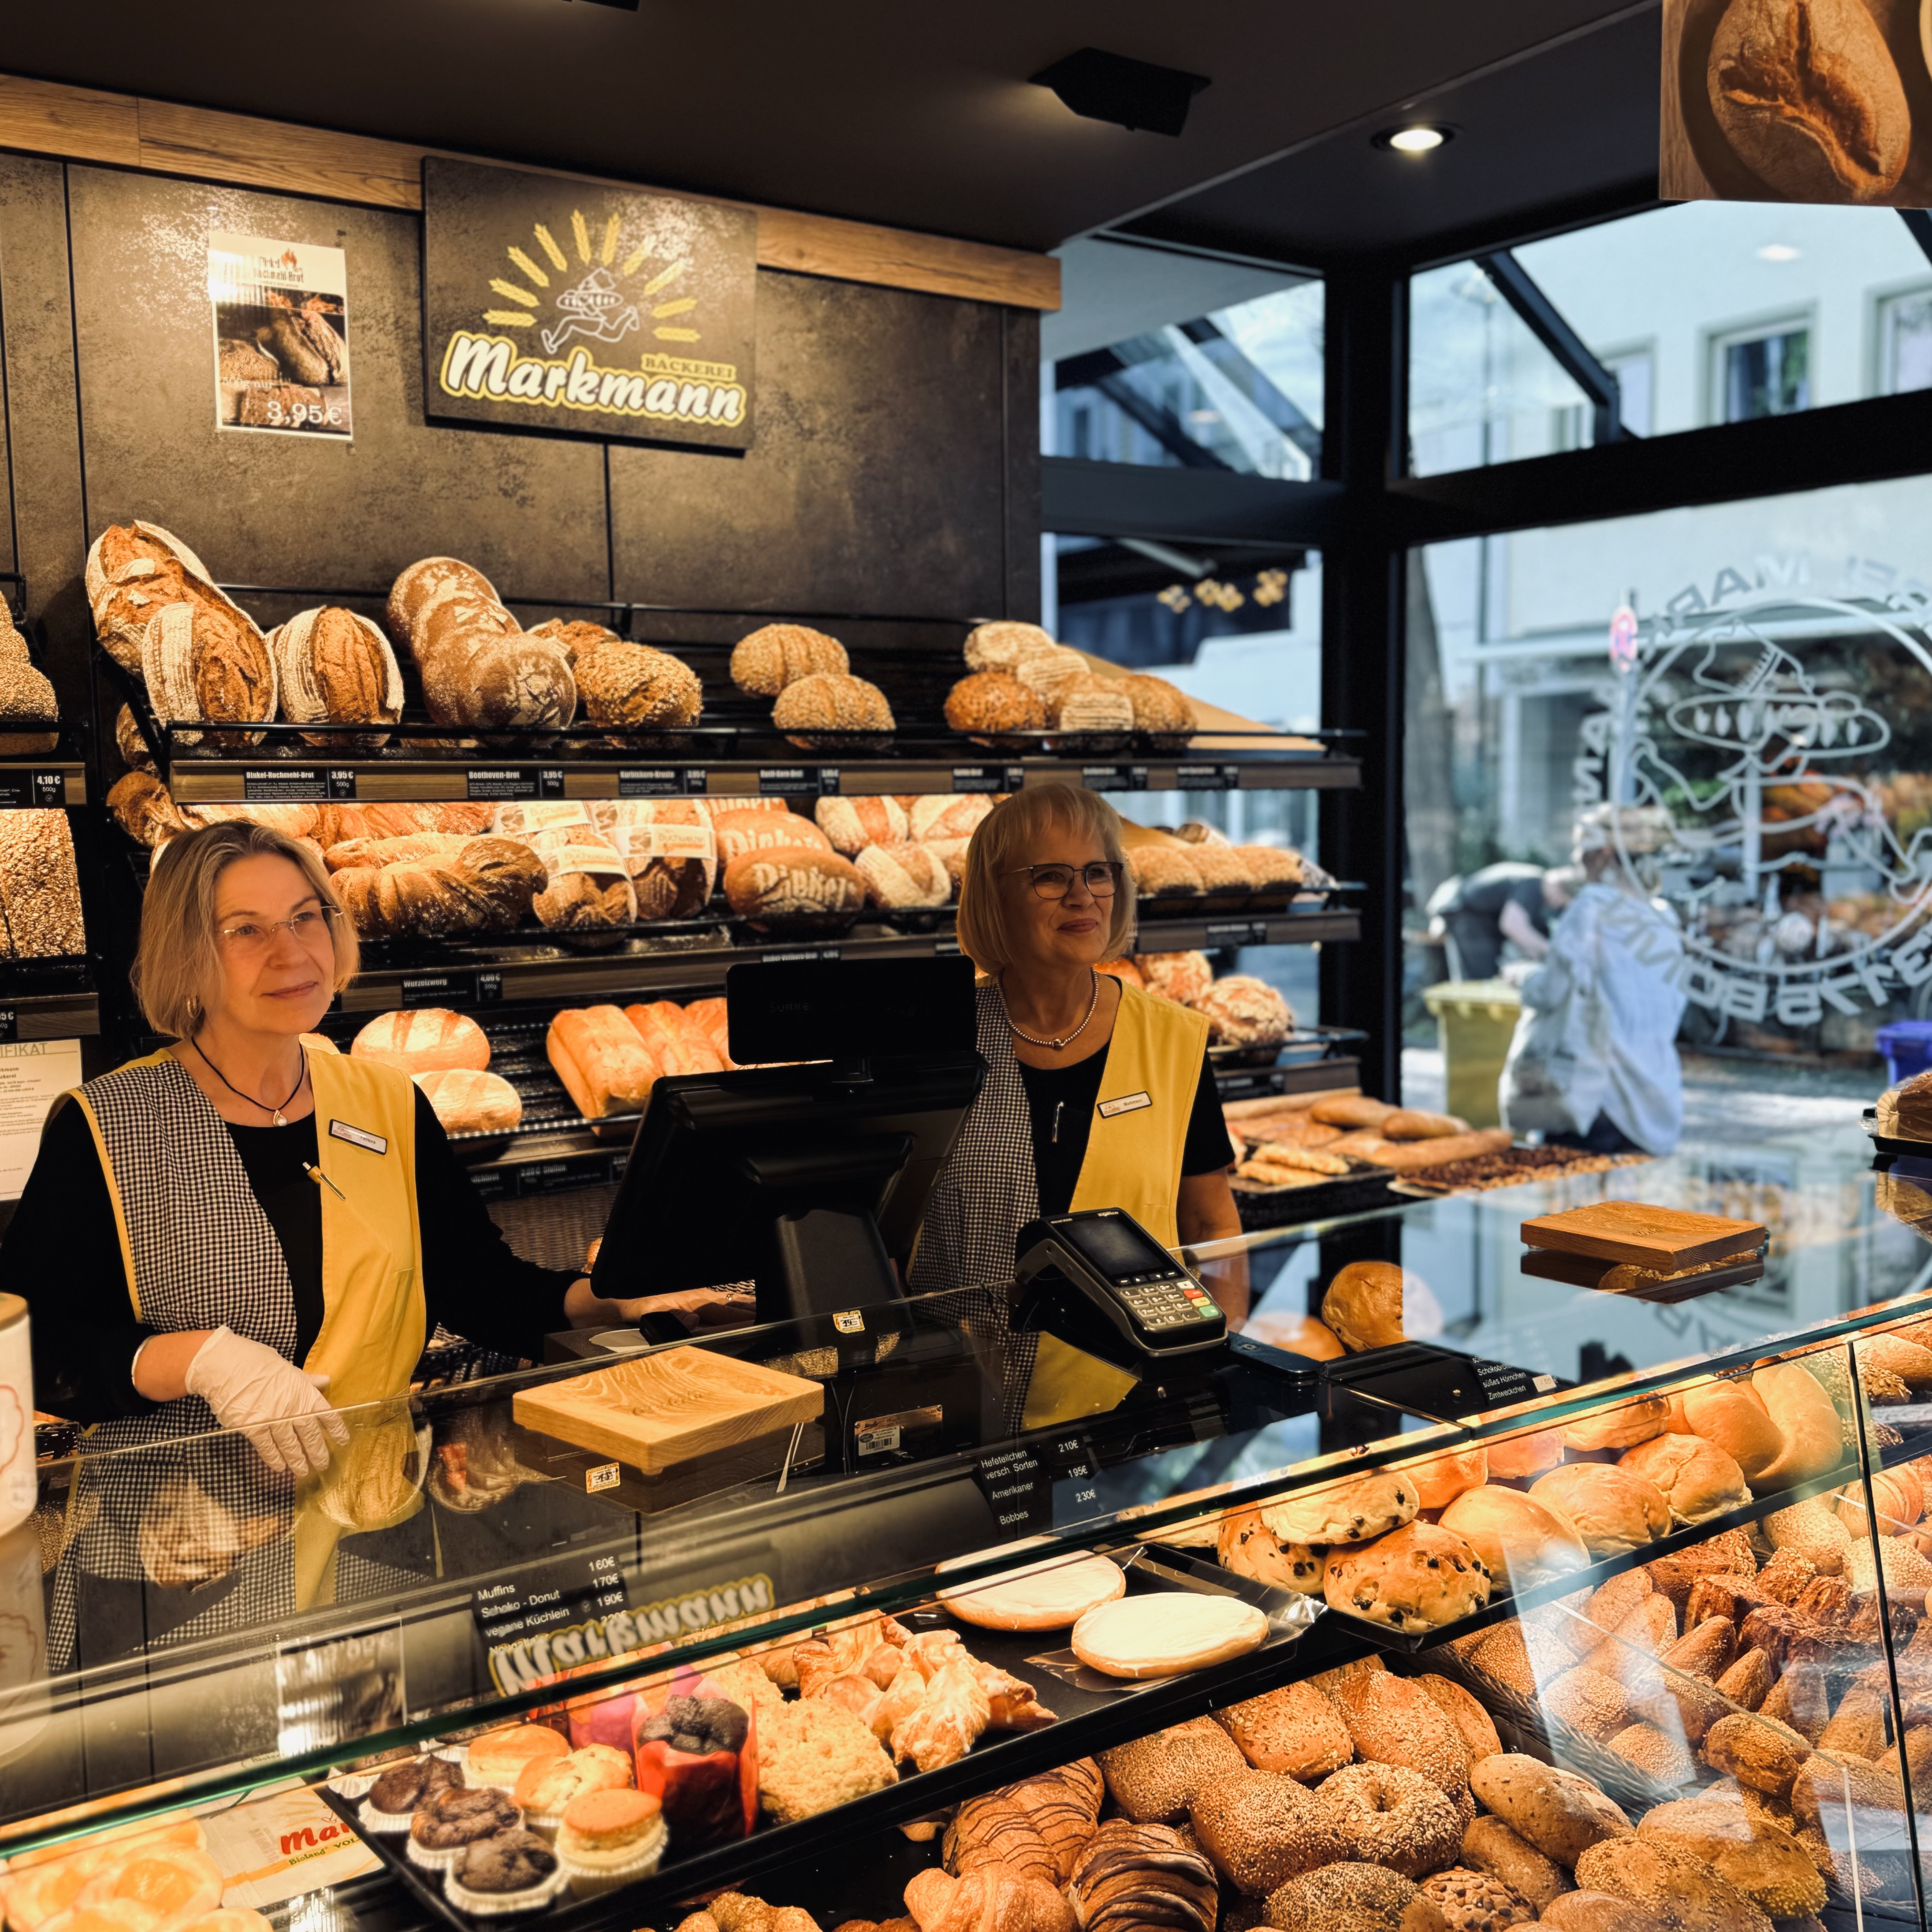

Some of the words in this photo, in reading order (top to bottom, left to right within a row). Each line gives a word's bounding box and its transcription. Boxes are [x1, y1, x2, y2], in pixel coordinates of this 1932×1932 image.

[645, 355, 733, 379] BÄCKEREI
[446, 333, 742, 423] Markmann
[1500, 1372, 1526, 1383] Hörnchen
[1487, 1385, 1527, 1400] Zimtweckchen
[981, 1450, 1027, 1468] Hefeteilchen
[1013, 1460, 1038, 1472] Sorten
[992, 1482, 1033, 1500] Amerikaner
[1000, 1511, 1029, 1525] Bobbes
[477, 1585, 515, 1601] Muffins
[481, 1601, 520, 1618] Schoko
[529, 1590, 561, 1605] Donut
[525, 1608, 570, 1627] Küchlein
